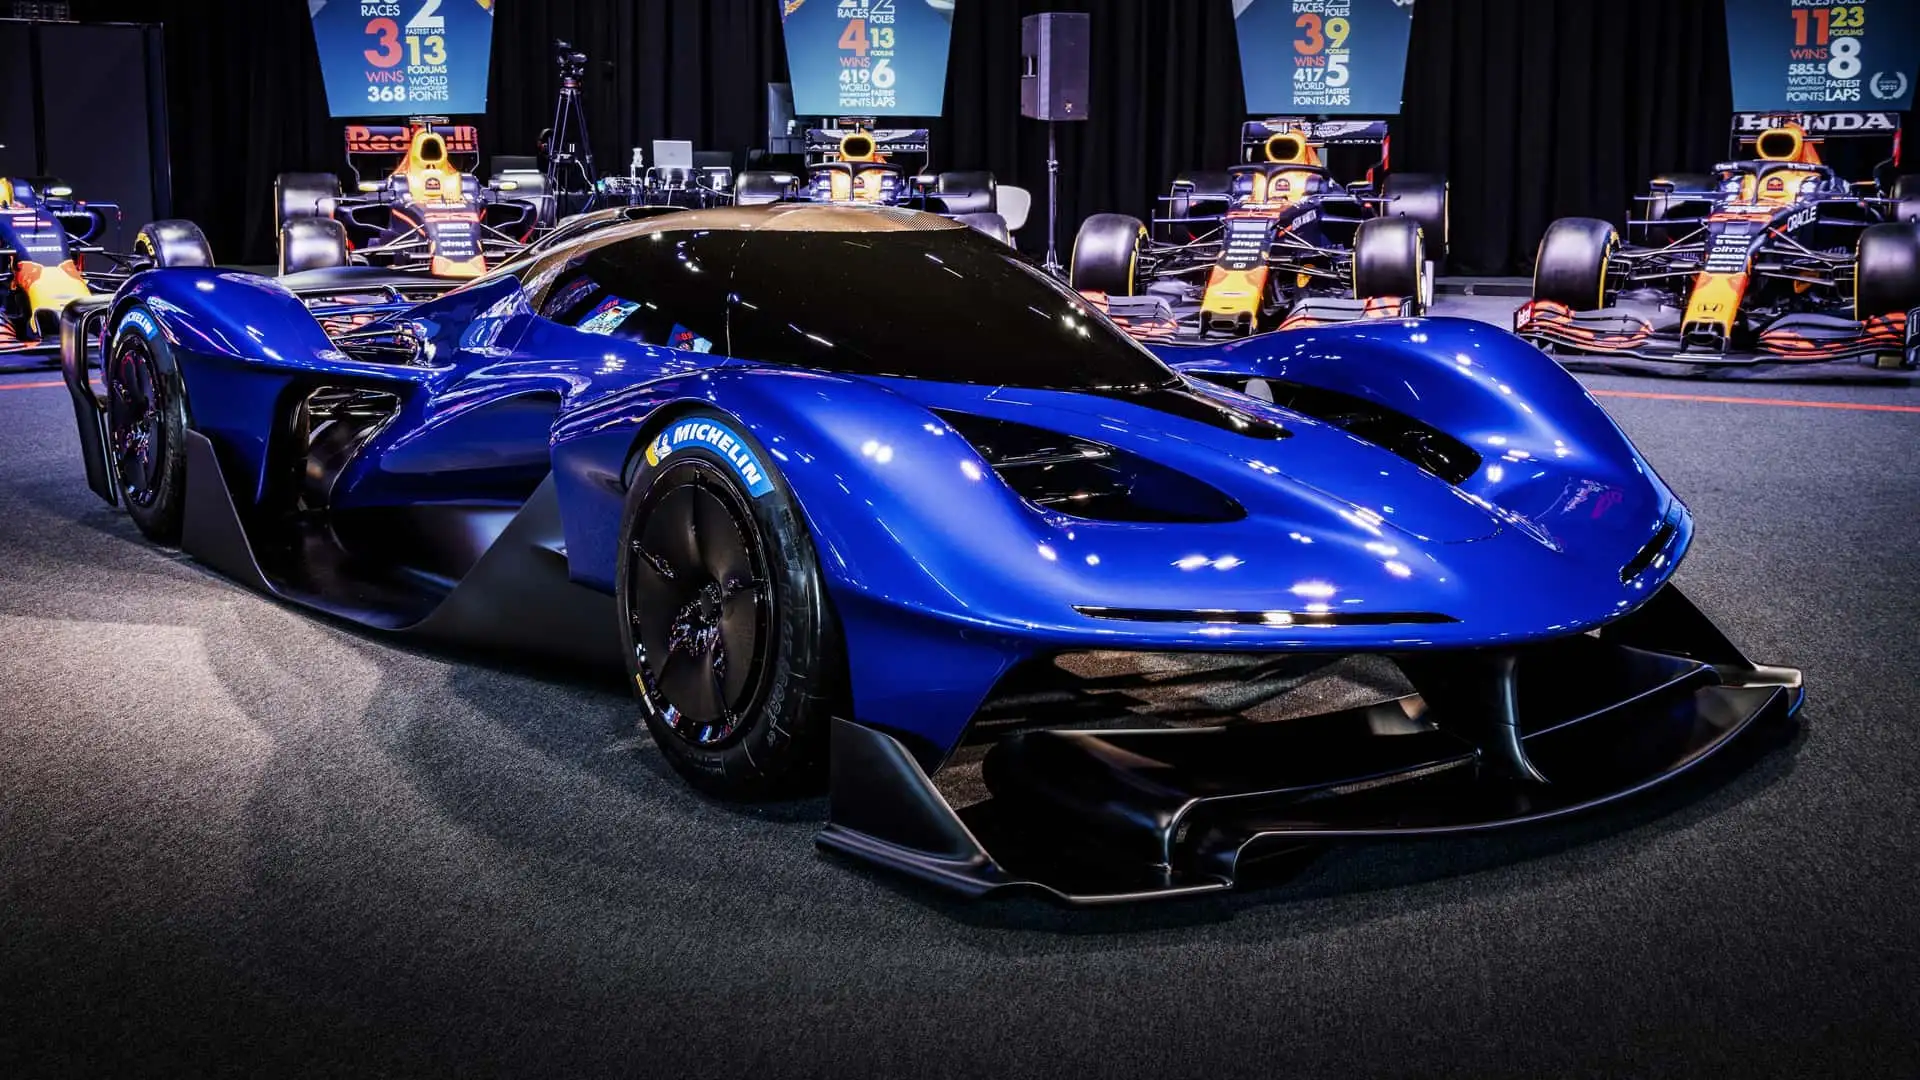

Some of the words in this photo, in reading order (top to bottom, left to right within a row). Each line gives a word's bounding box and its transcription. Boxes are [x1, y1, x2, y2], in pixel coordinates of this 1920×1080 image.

[361, 5, 400, 16] RACES
[837, 9, 869, 18] RACES
[1293, 3, 1324, 13] RACES
[1325, 8, 1350, 16] POLES
[870, 15, 895, 23] POLES
[1831, 6, 1864, 28] 23
[1325, 18, 1350, 48] 9
[1791, 9, 1829, 46] 11
[838, 19, 870, 57] 4
[870, 28, 895, 48] 13
[1294, 14, 1325, 55] 3
[364, 18, 403, 68] 3
[405, 36, 447, 65] 13
[1790, 49, 1828, 60] WINS
[840, 57, 871, 67] WINS
[1294, 56, 1325, 67] WINS
[1827, 37, 1862, 79] 8
[408, 65, 447, 74] PODIUMS
[872, 59, 895, 88] 6
[1325, 55, 1349, 87] 5
[1788, 63, 1826, 75] 585.5
[366, 71, 405, 83] WINS
[839, 70, 870, 83] 419
[1293, 68, 1324, 82] 417
[1788, 76, 1826, 85] WORLD
[409, 76, 448, 86] WORLD
[1294, 82, 1325, 90] WORLD
[1826, 80, 1862, 88] FASTEST
[840, 84, 870, 92] WORLD
[368, 86, 405, 102] 368
[409, 91, 449, 101] POINTS
[1786, 92, 1825, 102] POINTS
[1826, 89, 1861, 102] LAPS
[839, 98, 870, 107] POINTS
[871, 98, 896, 108] LAPS
[1293, 97, 1325, 106] POINTS
[1325, 95, 1350, 105] LAPS
[349, 126, 410, 150] Red
[1787, 206, 1817, 232] ORACLE
[673, 423, 761, 485] MICHELIN
